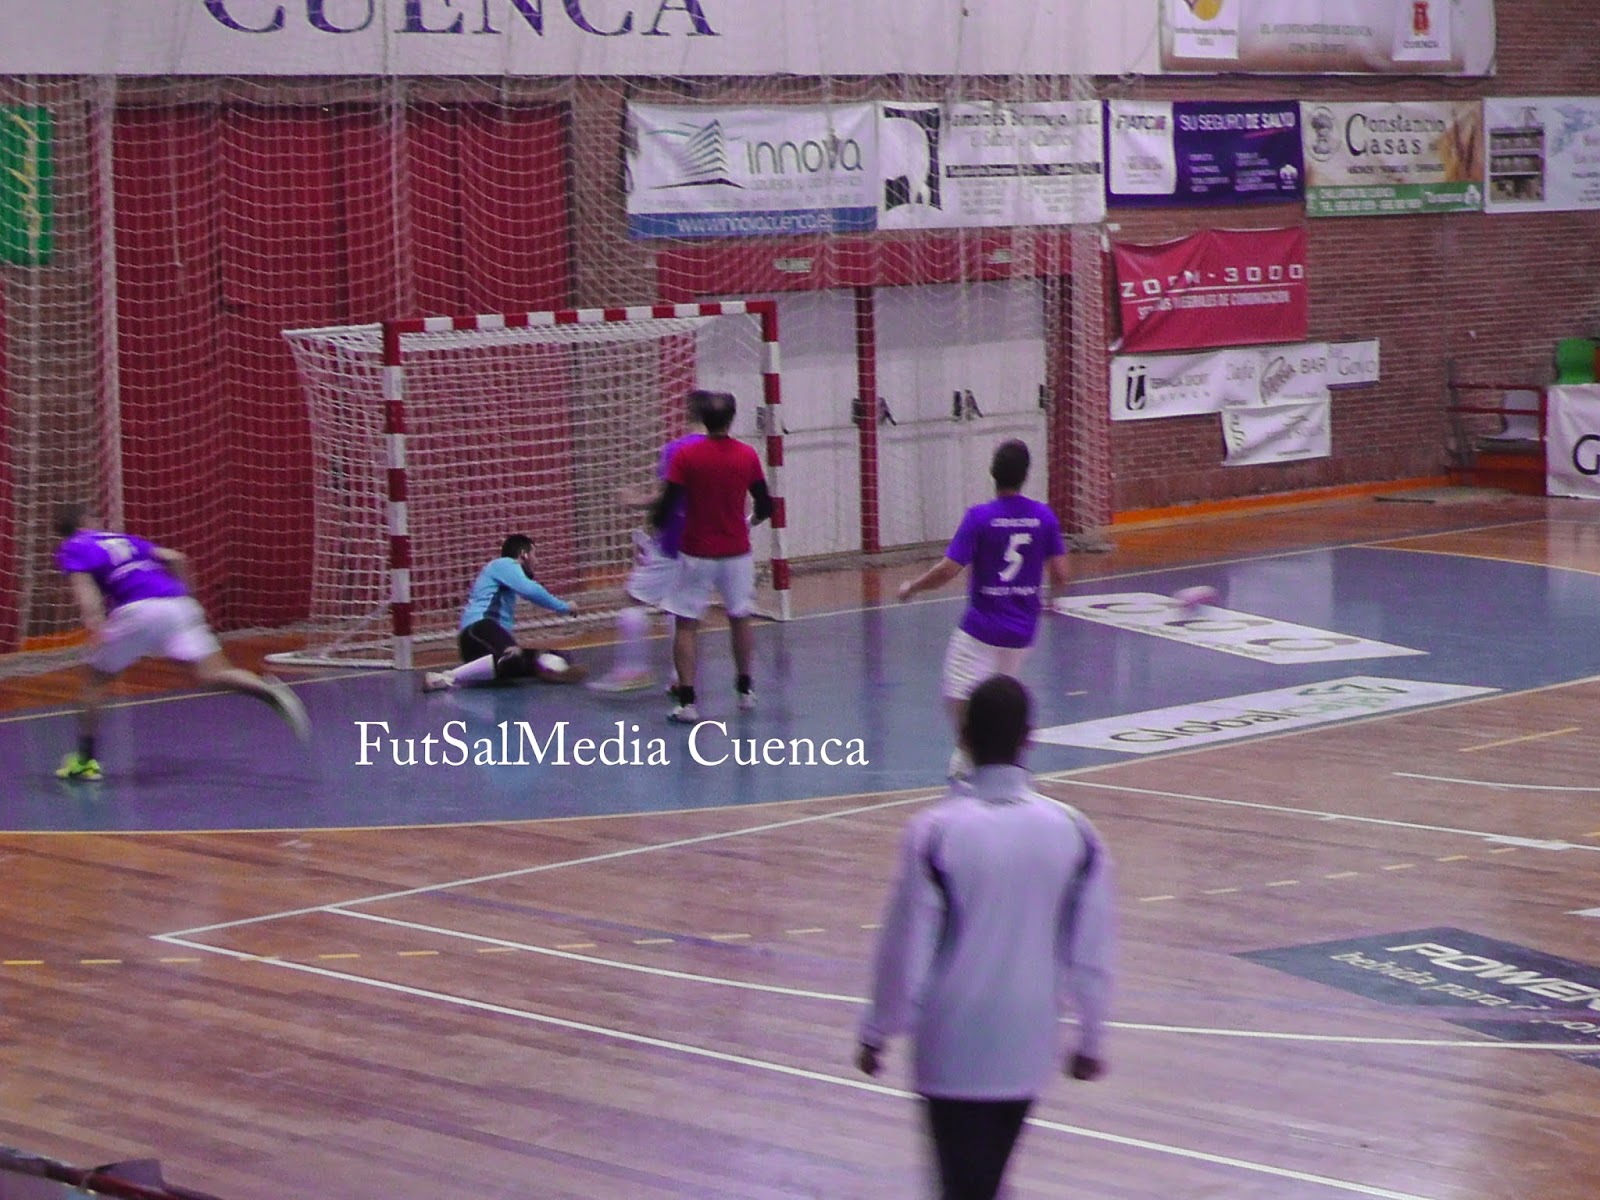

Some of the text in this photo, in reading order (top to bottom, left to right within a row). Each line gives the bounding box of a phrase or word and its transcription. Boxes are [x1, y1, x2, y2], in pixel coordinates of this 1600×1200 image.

[1179, 114, 1198, 131] SU
[1199, 113, 1244, 131] SEGURO
[1245, 112, 1260, 130] DE
[998, 533, 1033, 582] 5
